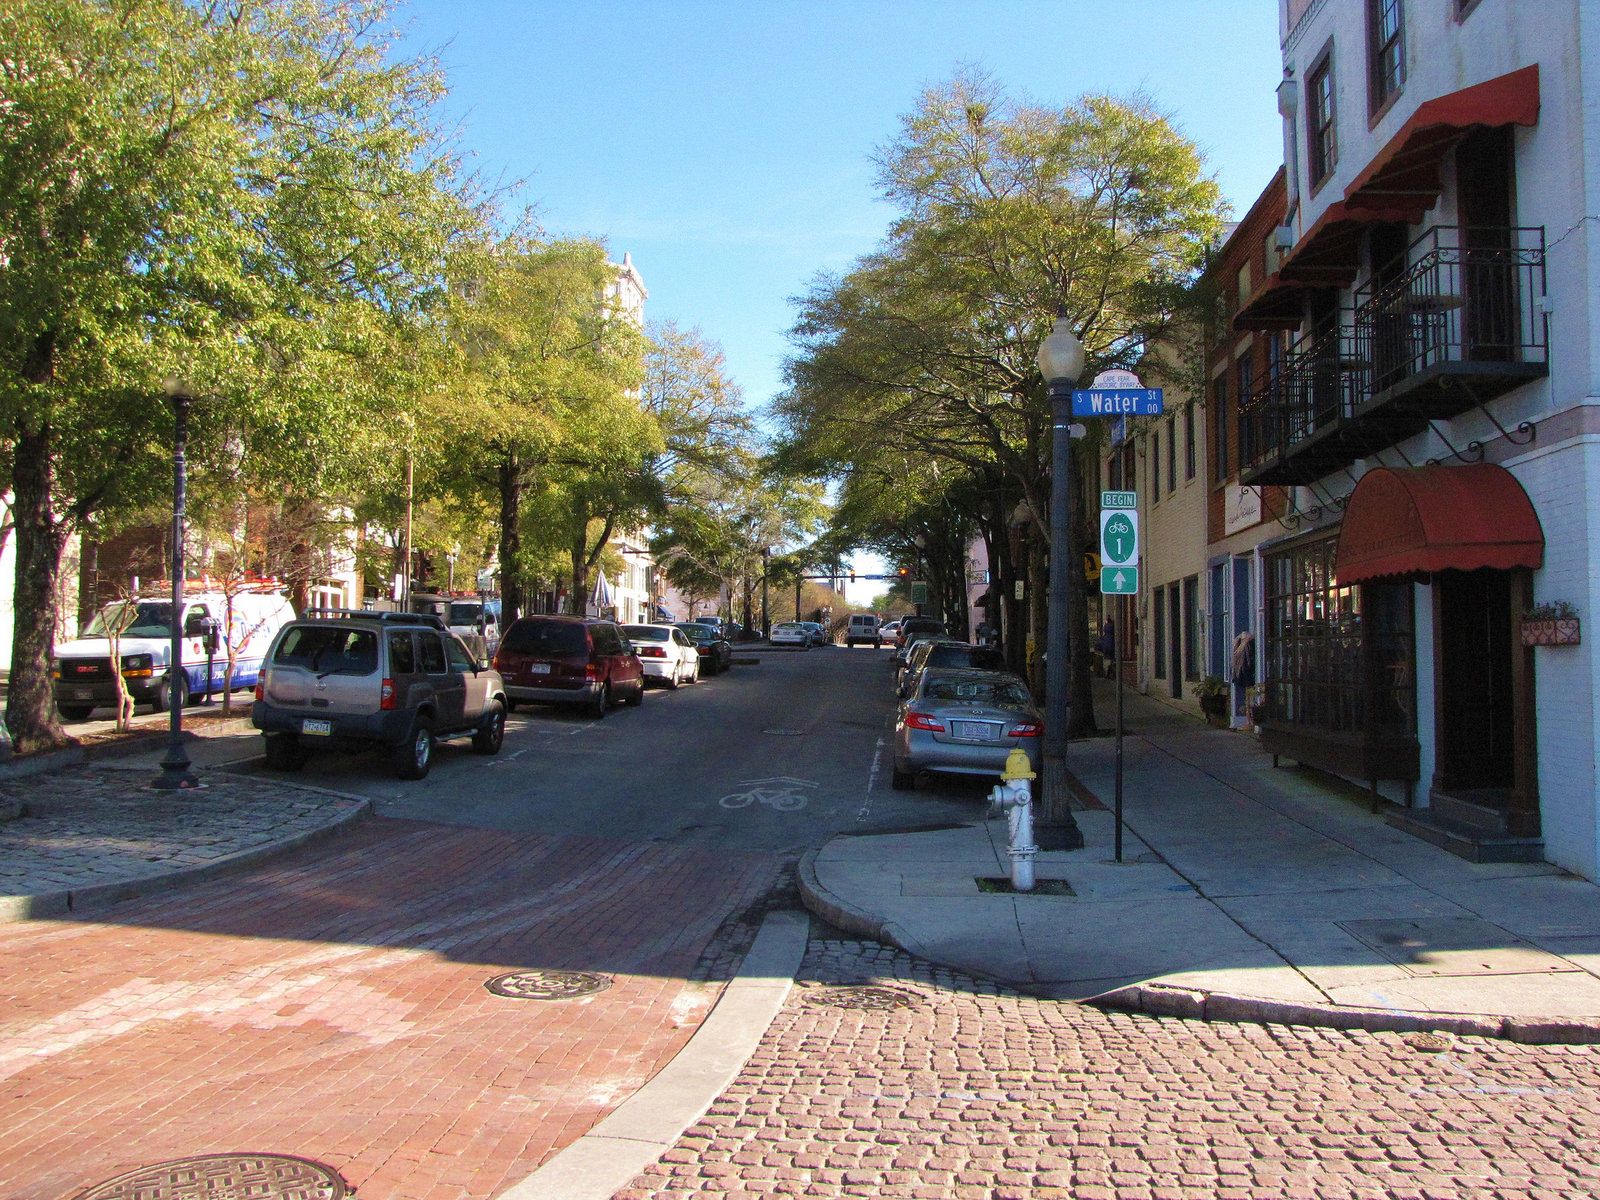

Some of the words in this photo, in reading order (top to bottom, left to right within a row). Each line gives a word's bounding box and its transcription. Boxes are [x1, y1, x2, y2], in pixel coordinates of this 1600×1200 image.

[1077, 393, 1083, 403] S
[1091, 393, 1138, 412] Water
[1147, 390, 1156, 400] St
[1147, 403, 1158, 413] 00
[1105, 494, 1133, 506] BEGIN
[1116, 538, 1122, 555] 1
